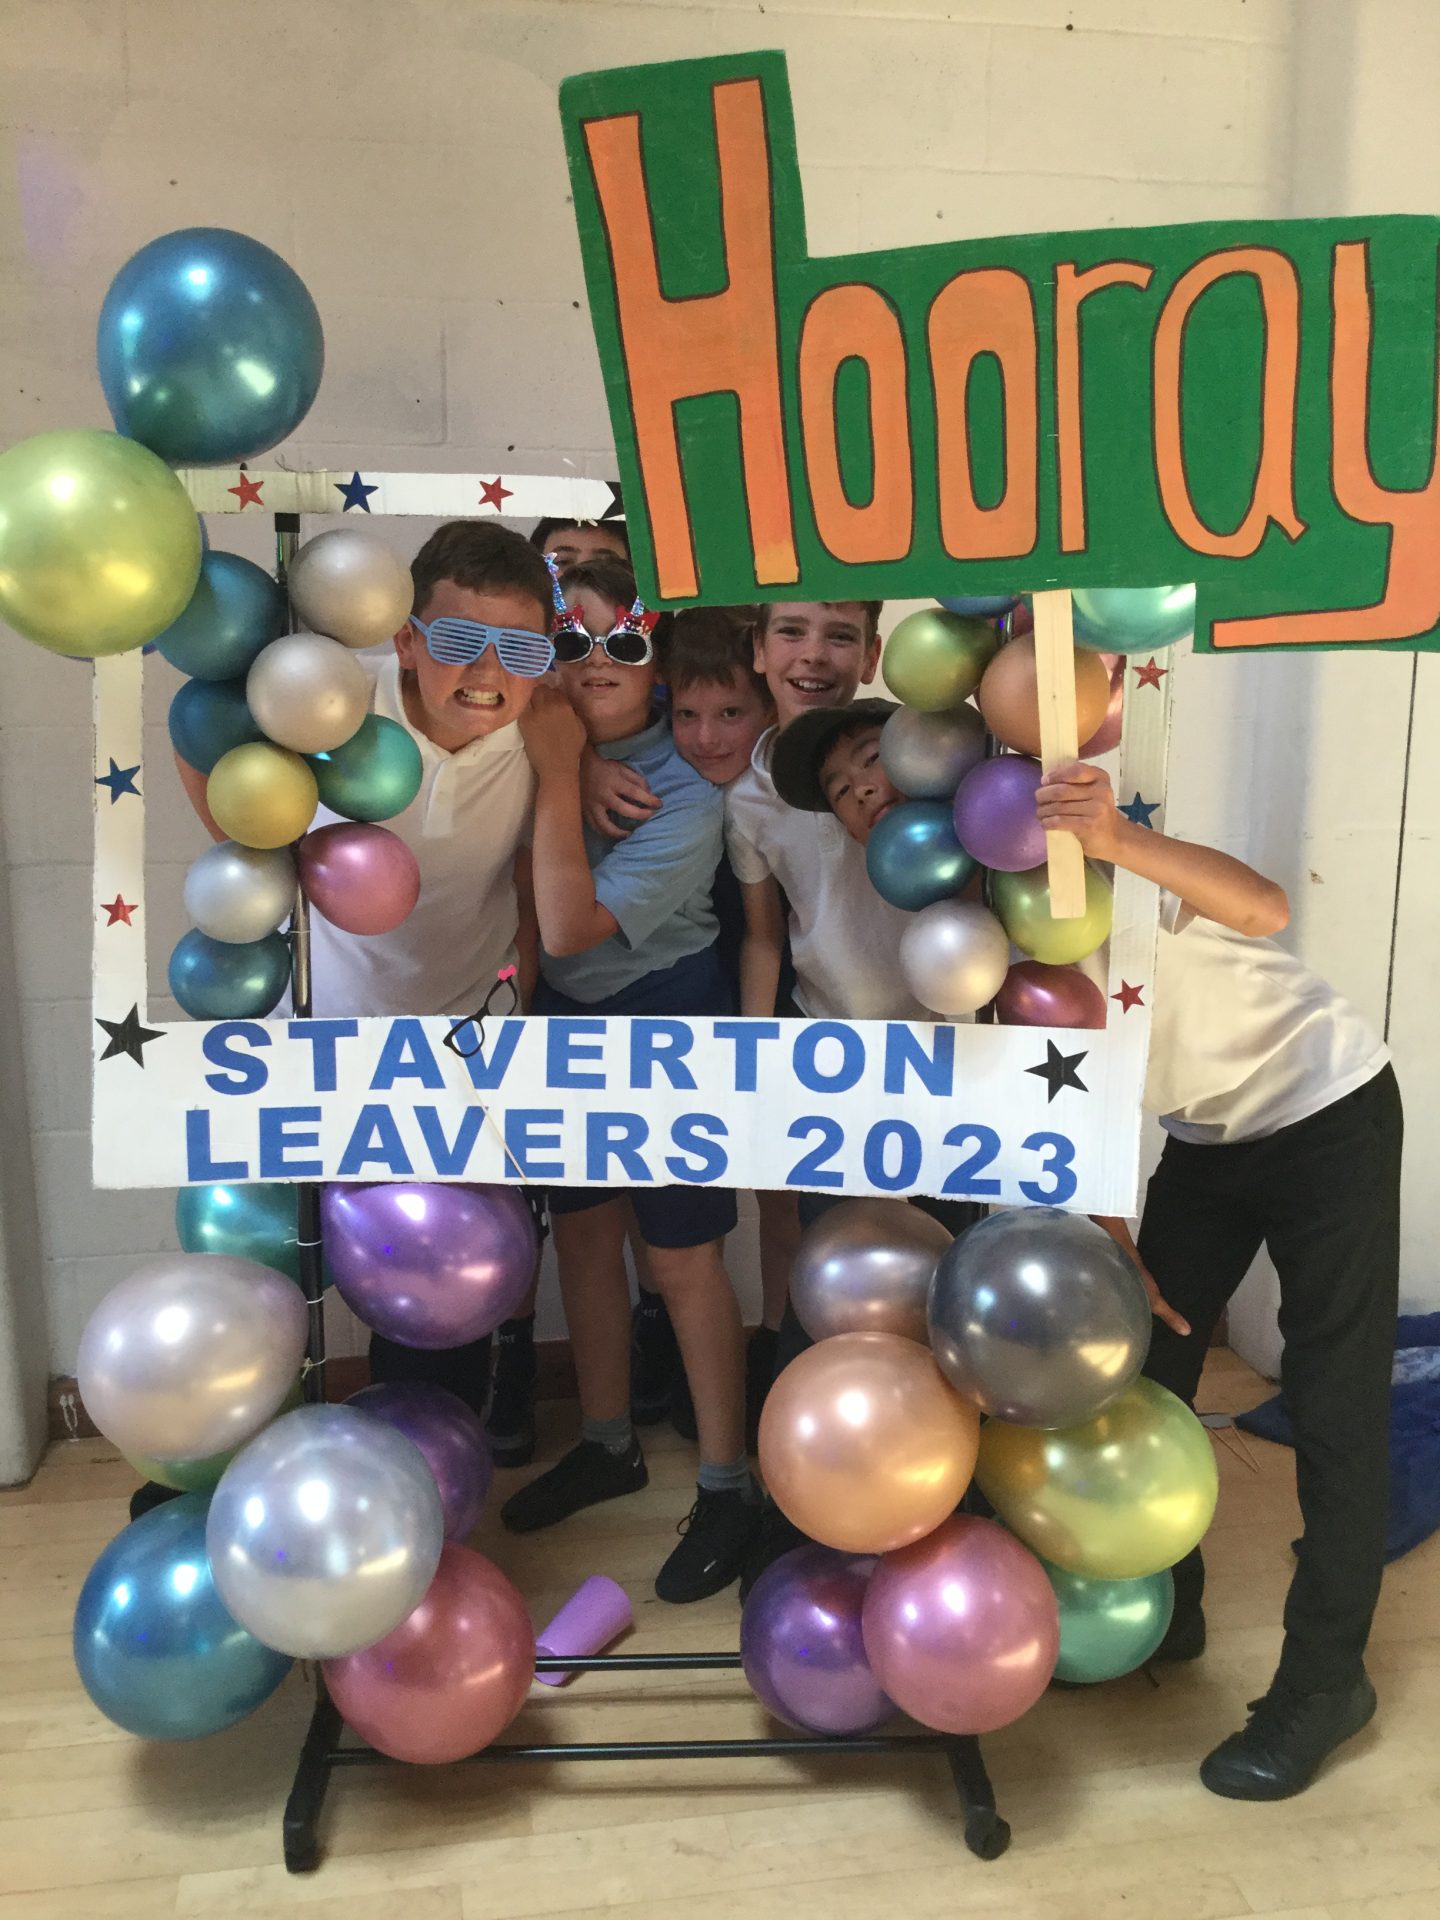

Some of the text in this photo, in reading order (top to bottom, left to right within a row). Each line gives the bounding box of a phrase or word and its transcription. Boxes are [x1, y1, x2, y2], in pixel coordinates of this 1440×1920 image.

[581, 76, 1440, 650] Hooray
[202, 1017, 956, 1097] STAVERTON
[186, 1103, 1079, 1205] LEAVERS 2023
